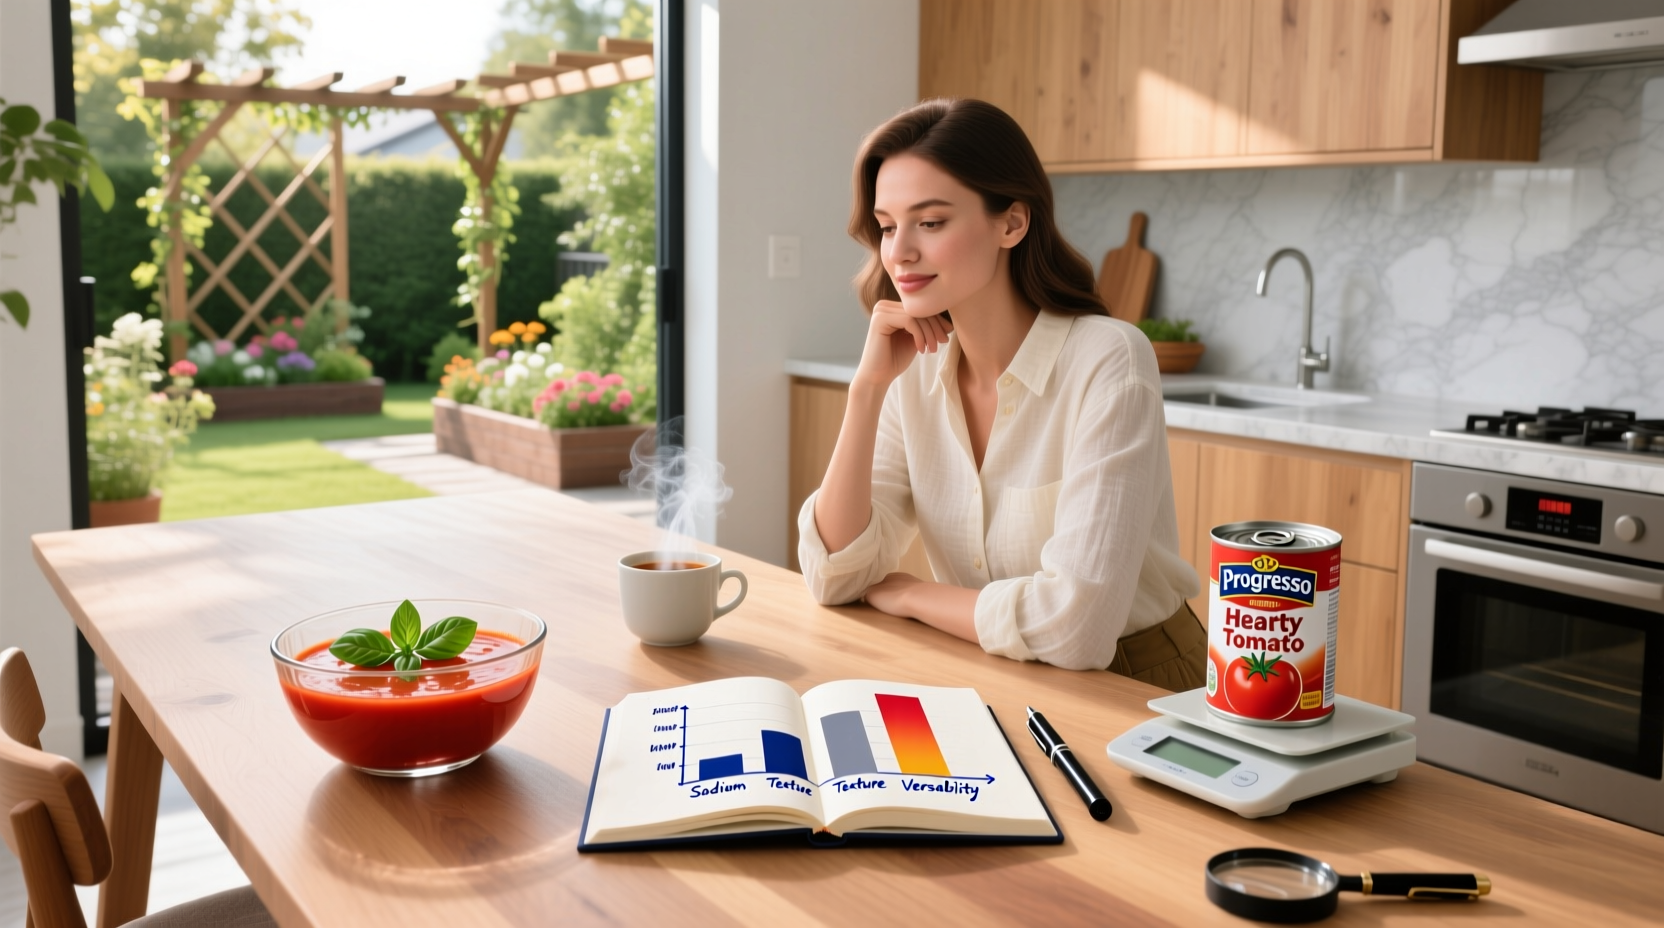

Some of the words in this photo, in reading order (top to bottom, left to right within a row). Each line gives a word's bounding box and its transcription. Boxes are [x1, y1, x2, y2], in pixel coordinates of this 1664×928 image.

[1223, 568, 1312, 595] Progresso
[1225, 607, 1303, 636] Hearty
[1223, 627, 1304, 653] Tomato
[690, 780, 746, 798] Sodium
